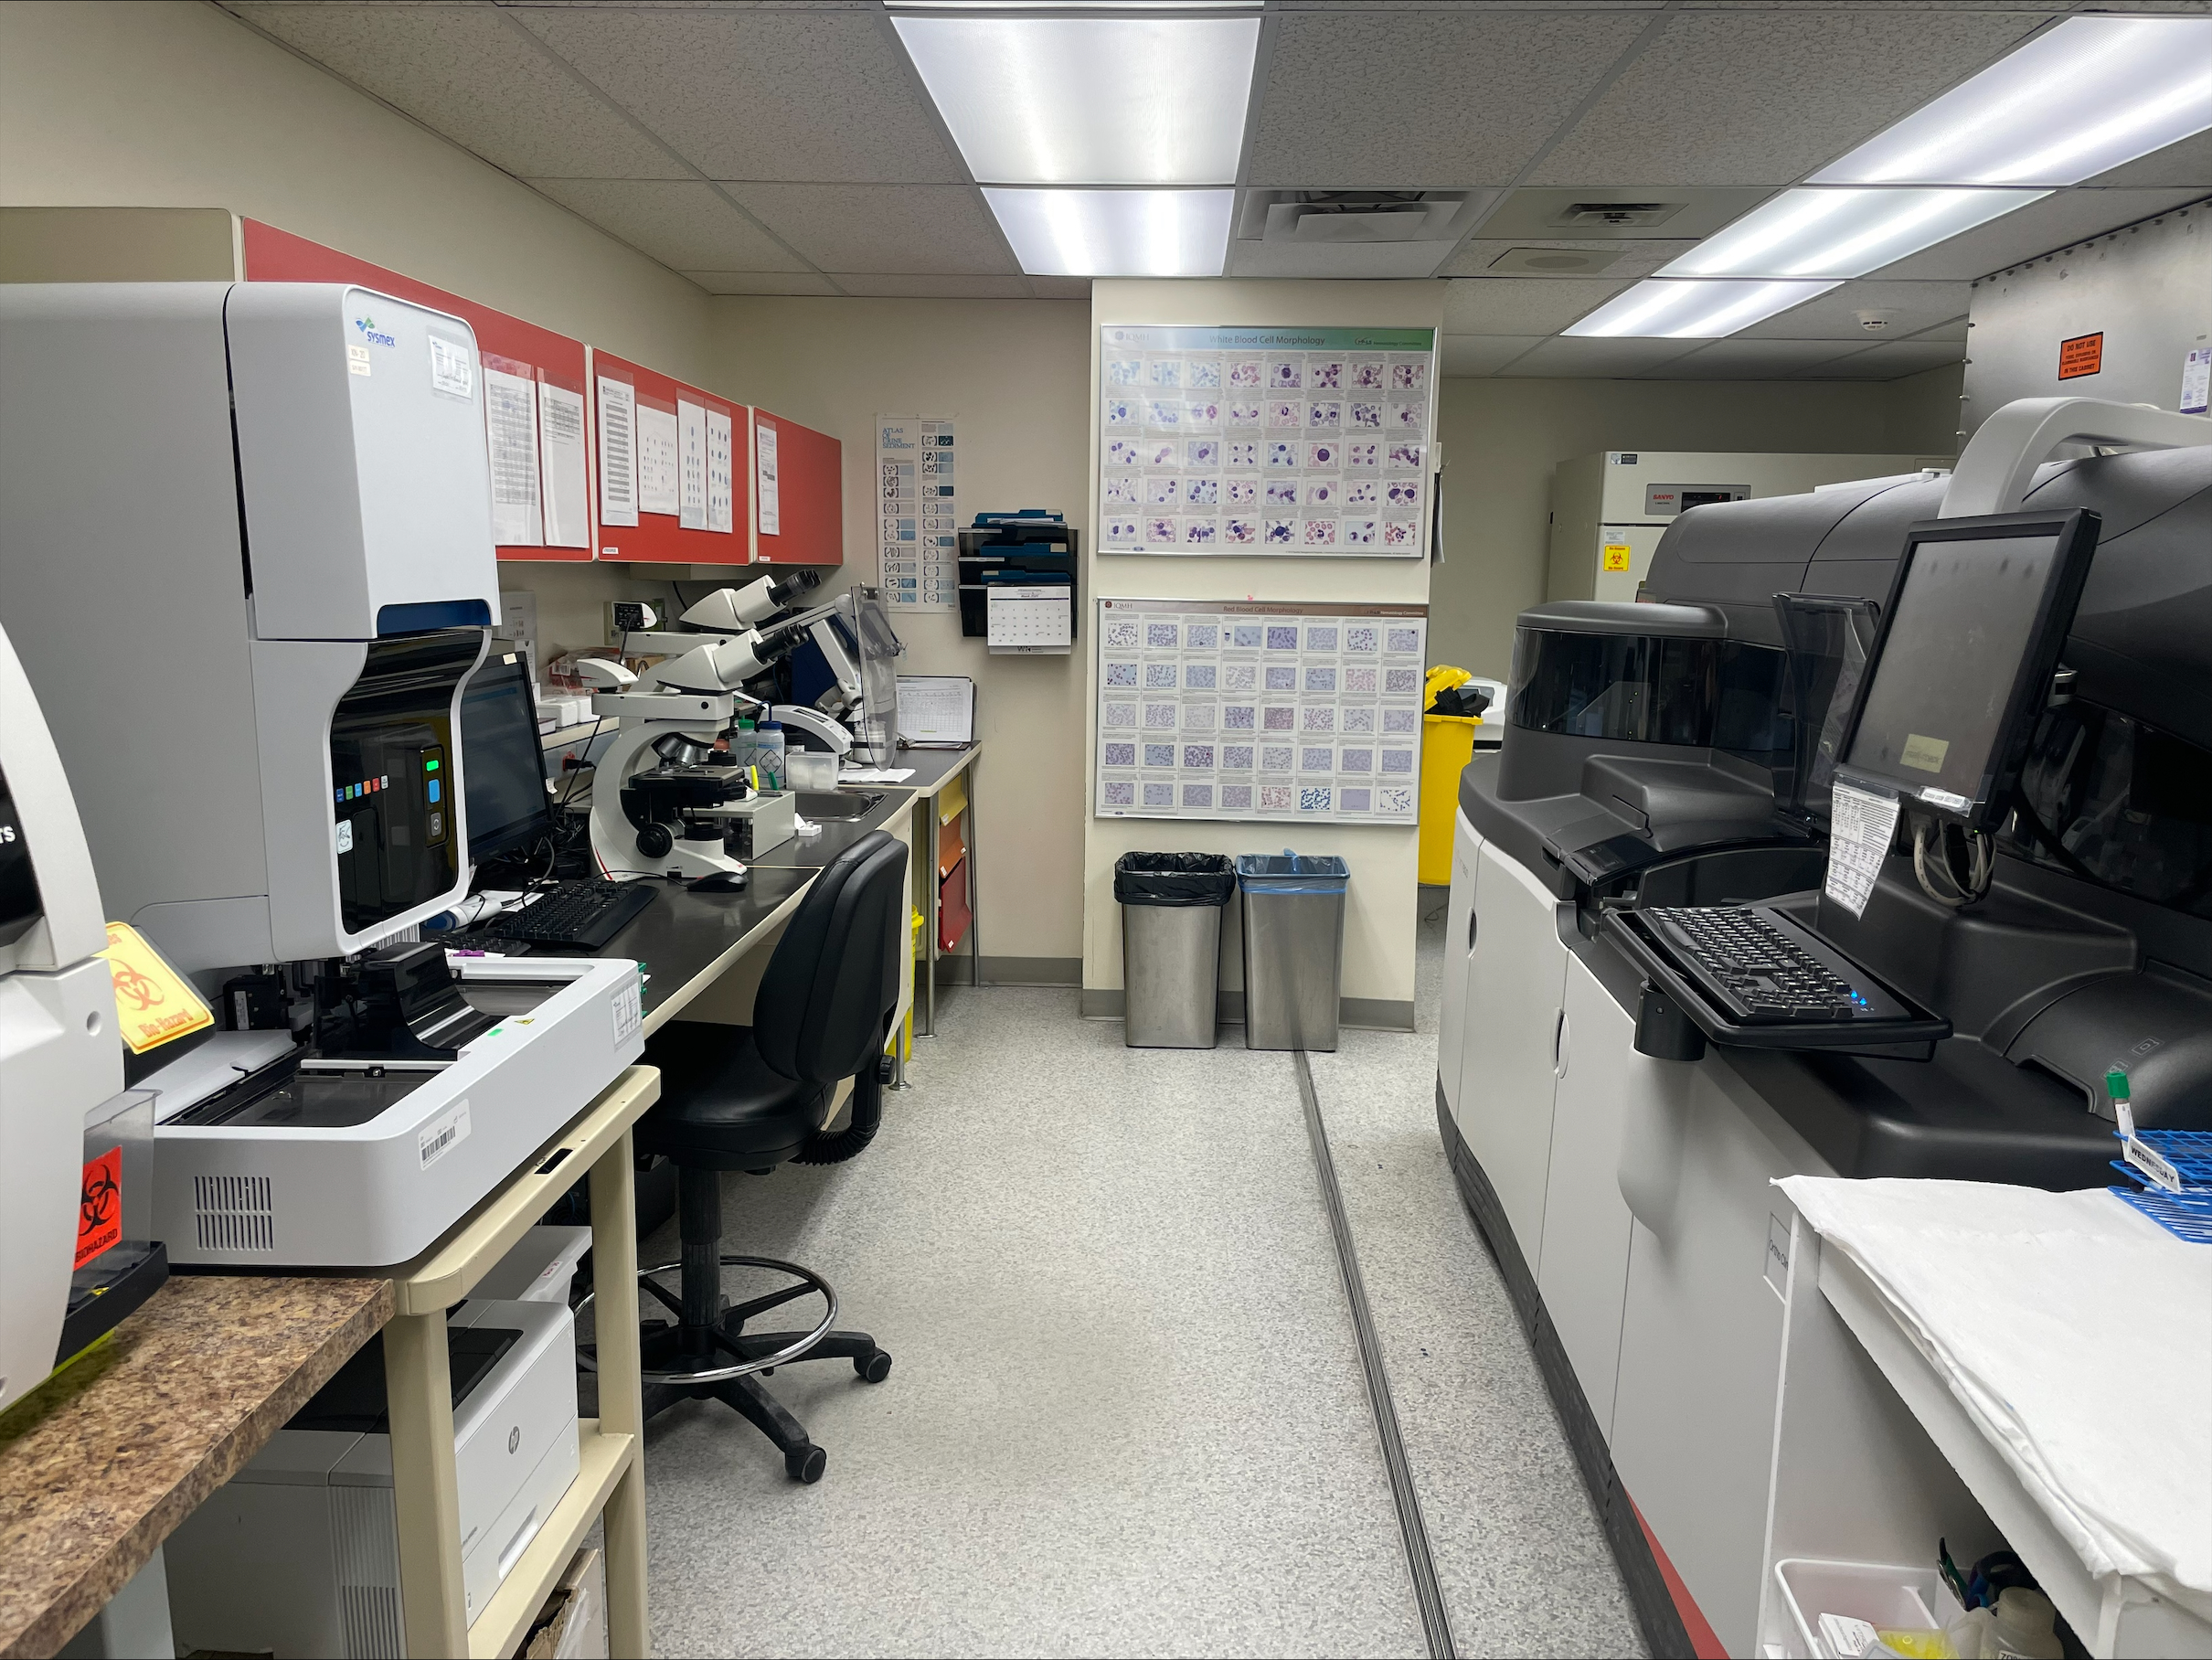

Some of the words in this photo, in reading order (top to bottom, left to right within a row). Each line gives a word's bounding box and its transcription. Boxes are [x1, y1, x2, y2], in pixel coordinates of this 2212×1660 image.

[367, 331, 395, 347] sysmex
[1125, 332, 1149, 342] IQMH
[1209, 335, 1233, 343] White
[1234, 335, 1257, 344] Blood
[1260, 335, 1274, 344] Cell
[1276, 335, 1325, 346] Morphology
[2067, 344, 2074, 352] DO
[2087, 339, 2096, 347] USE
[138, 1008, 194, 1038] Bio-Hazard
[76, 1229, 118, 1262] BIOHAZARD
